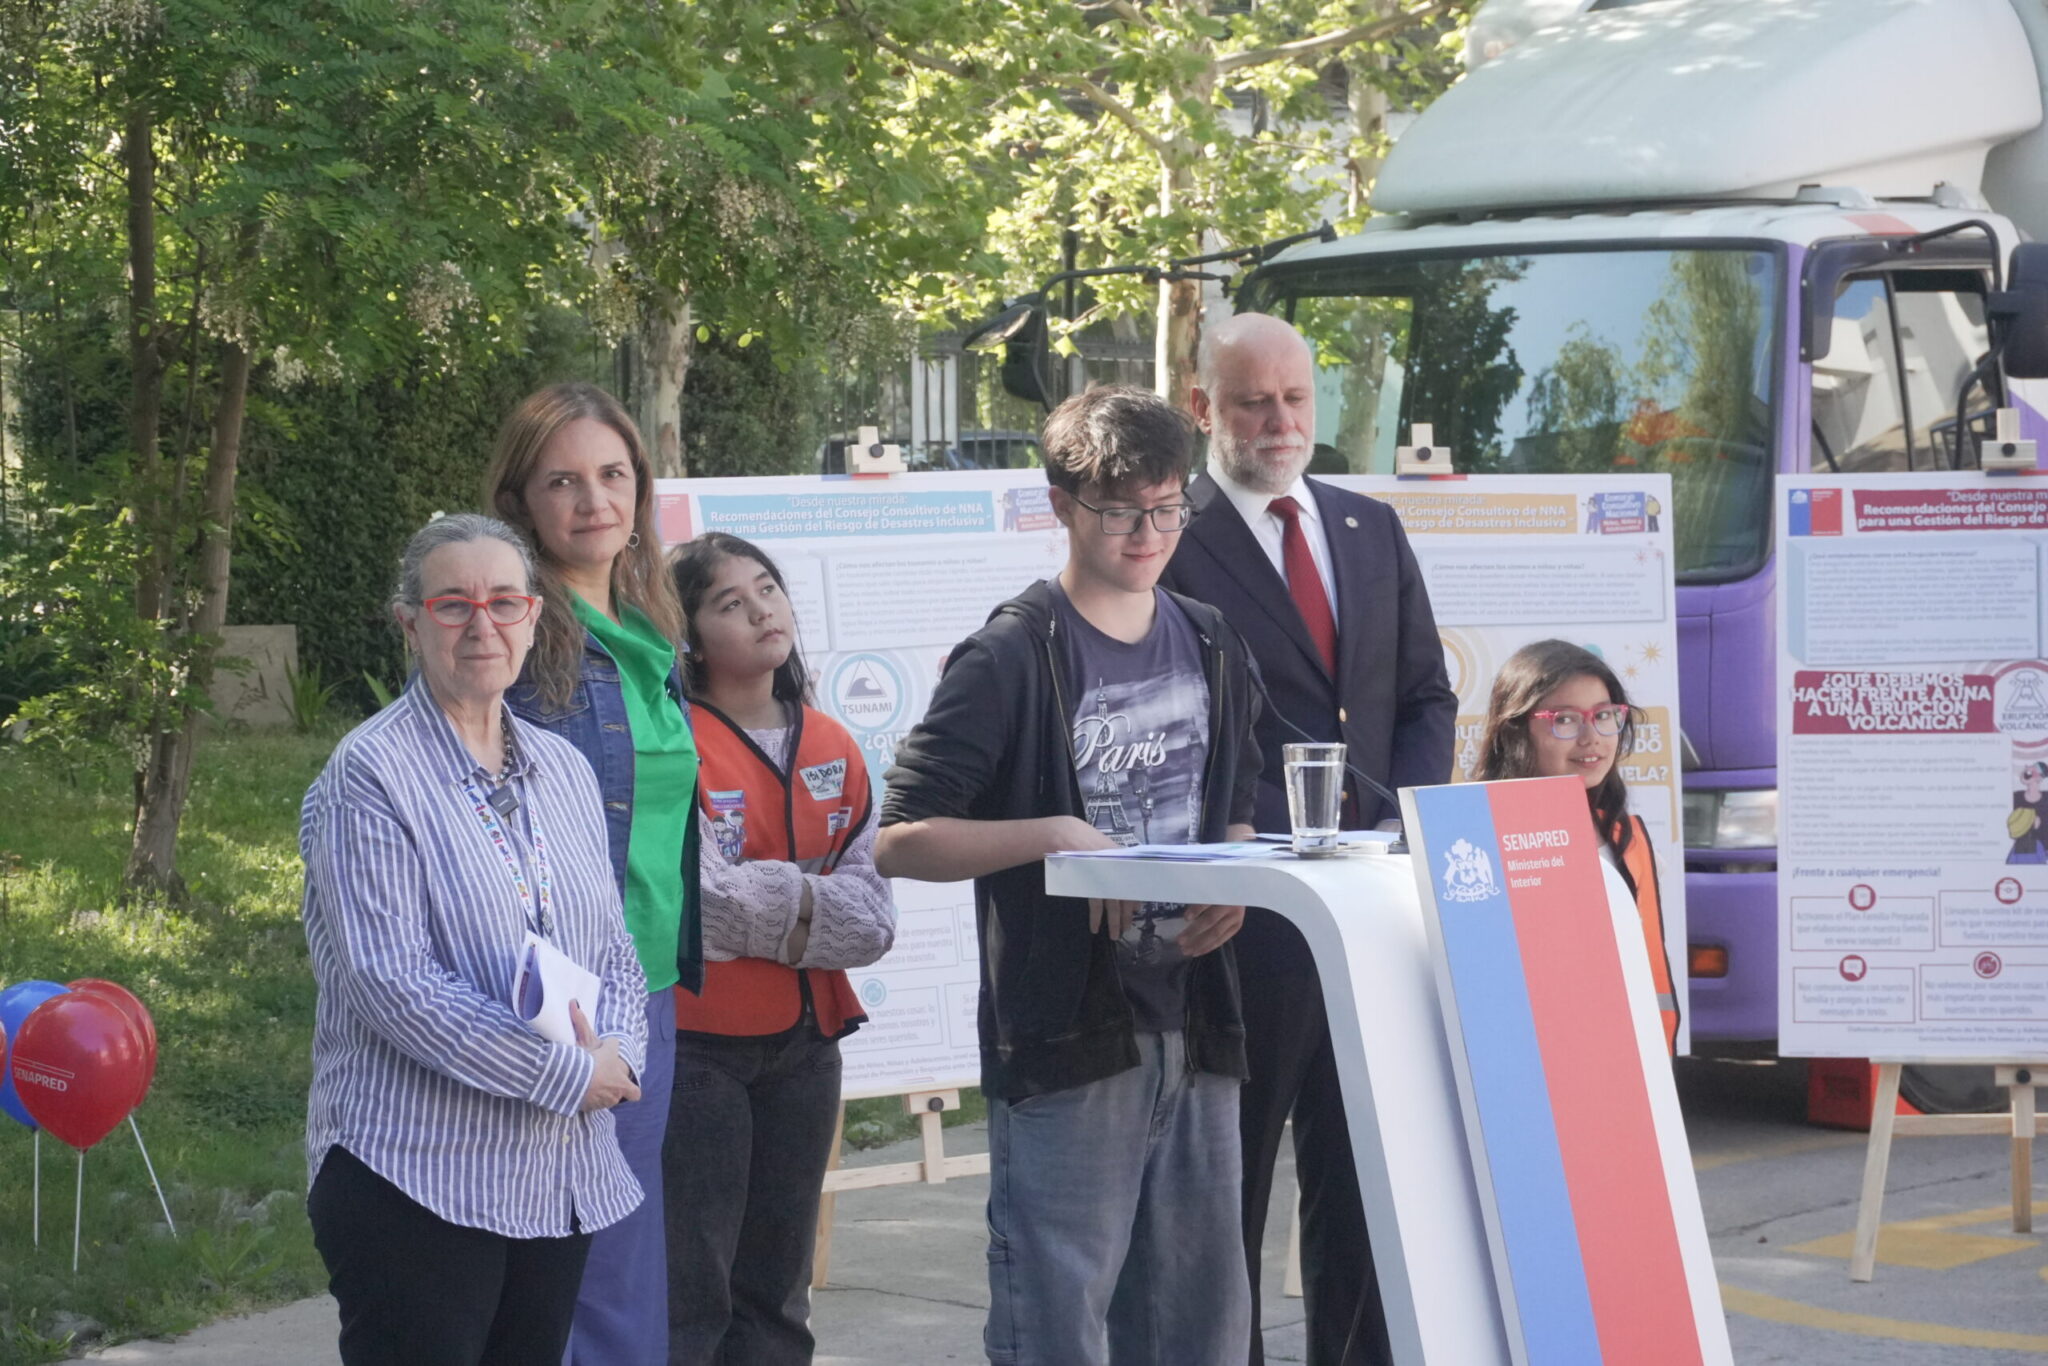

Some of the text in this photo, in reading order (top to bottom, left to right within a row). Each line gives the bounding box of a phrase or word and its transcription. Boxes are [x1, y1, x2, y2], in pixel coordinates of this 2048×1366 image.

[828, 494, 868, 506] nuestra
[869, 493, 907, 505] mirada:
[1403, 495, 1441, 506] nuestra
[1445, 495, 1486, 505] mirada:
[1990, 491, 2033, 501] nuestra
[711, 503, 984, 522] Recomendaciones del Consejo Consultivo de NNA
[1408, 506, 1454, 521] Consejo
[1458, 505, 1519, 517] Consultivo
[1523, 505, 1537, 516] de
[1540, 505, 1566, 516] NNA
[1863, 500, 2047, 517] Recomendaciones del Consejo
[735, 524, 756, 534] una
[759, 521, 802, 533] Gestión
[804, 519, 822, 532] del
[825, 519, 862, 531] Riesgo
[865, 517, 878, 529] de
[881, 517, 935, 529] Desastres
[1439, 517, 1453, 528] de
[1456, 517, 1512, 529] Desastres
[1858, 511, 2046, 529] para una Gestión del Riesgo de
[1822, 671, 1964, 688] ¿QUÉ DEBEMOS
[1792, 685, 1992, 702] HACER FRENTE A UNA
[842, 702, 892, 714] TSUNAMI
[1808, 702, 1822, 716] A
[1826, 701, 1867, 716] UNA
[1073, 713, 1167, 773] Paris
[1502, 829, 1570, 852] SENAPRED
[1507, 856, 1565, 872] Ministerio del
[1793, 868, 1826, 879] ¡Frente
[1836, 868, 1880, 879] cualquier
[1882, 868, 1941, 879] emergencia!
[1510, 877, 1542, 889] Interior
[1845, 911, 1860, 920] Plan
[2024, 906, 2033, 915] de
[1858, 925, 1870, 933] con
[1903, 923, 1928, 933] familia
[1968, 920, 1981, 929] que
[1925, 981, 1934, 989] No
[14, 1066, 68, 1092] SENAPRED
